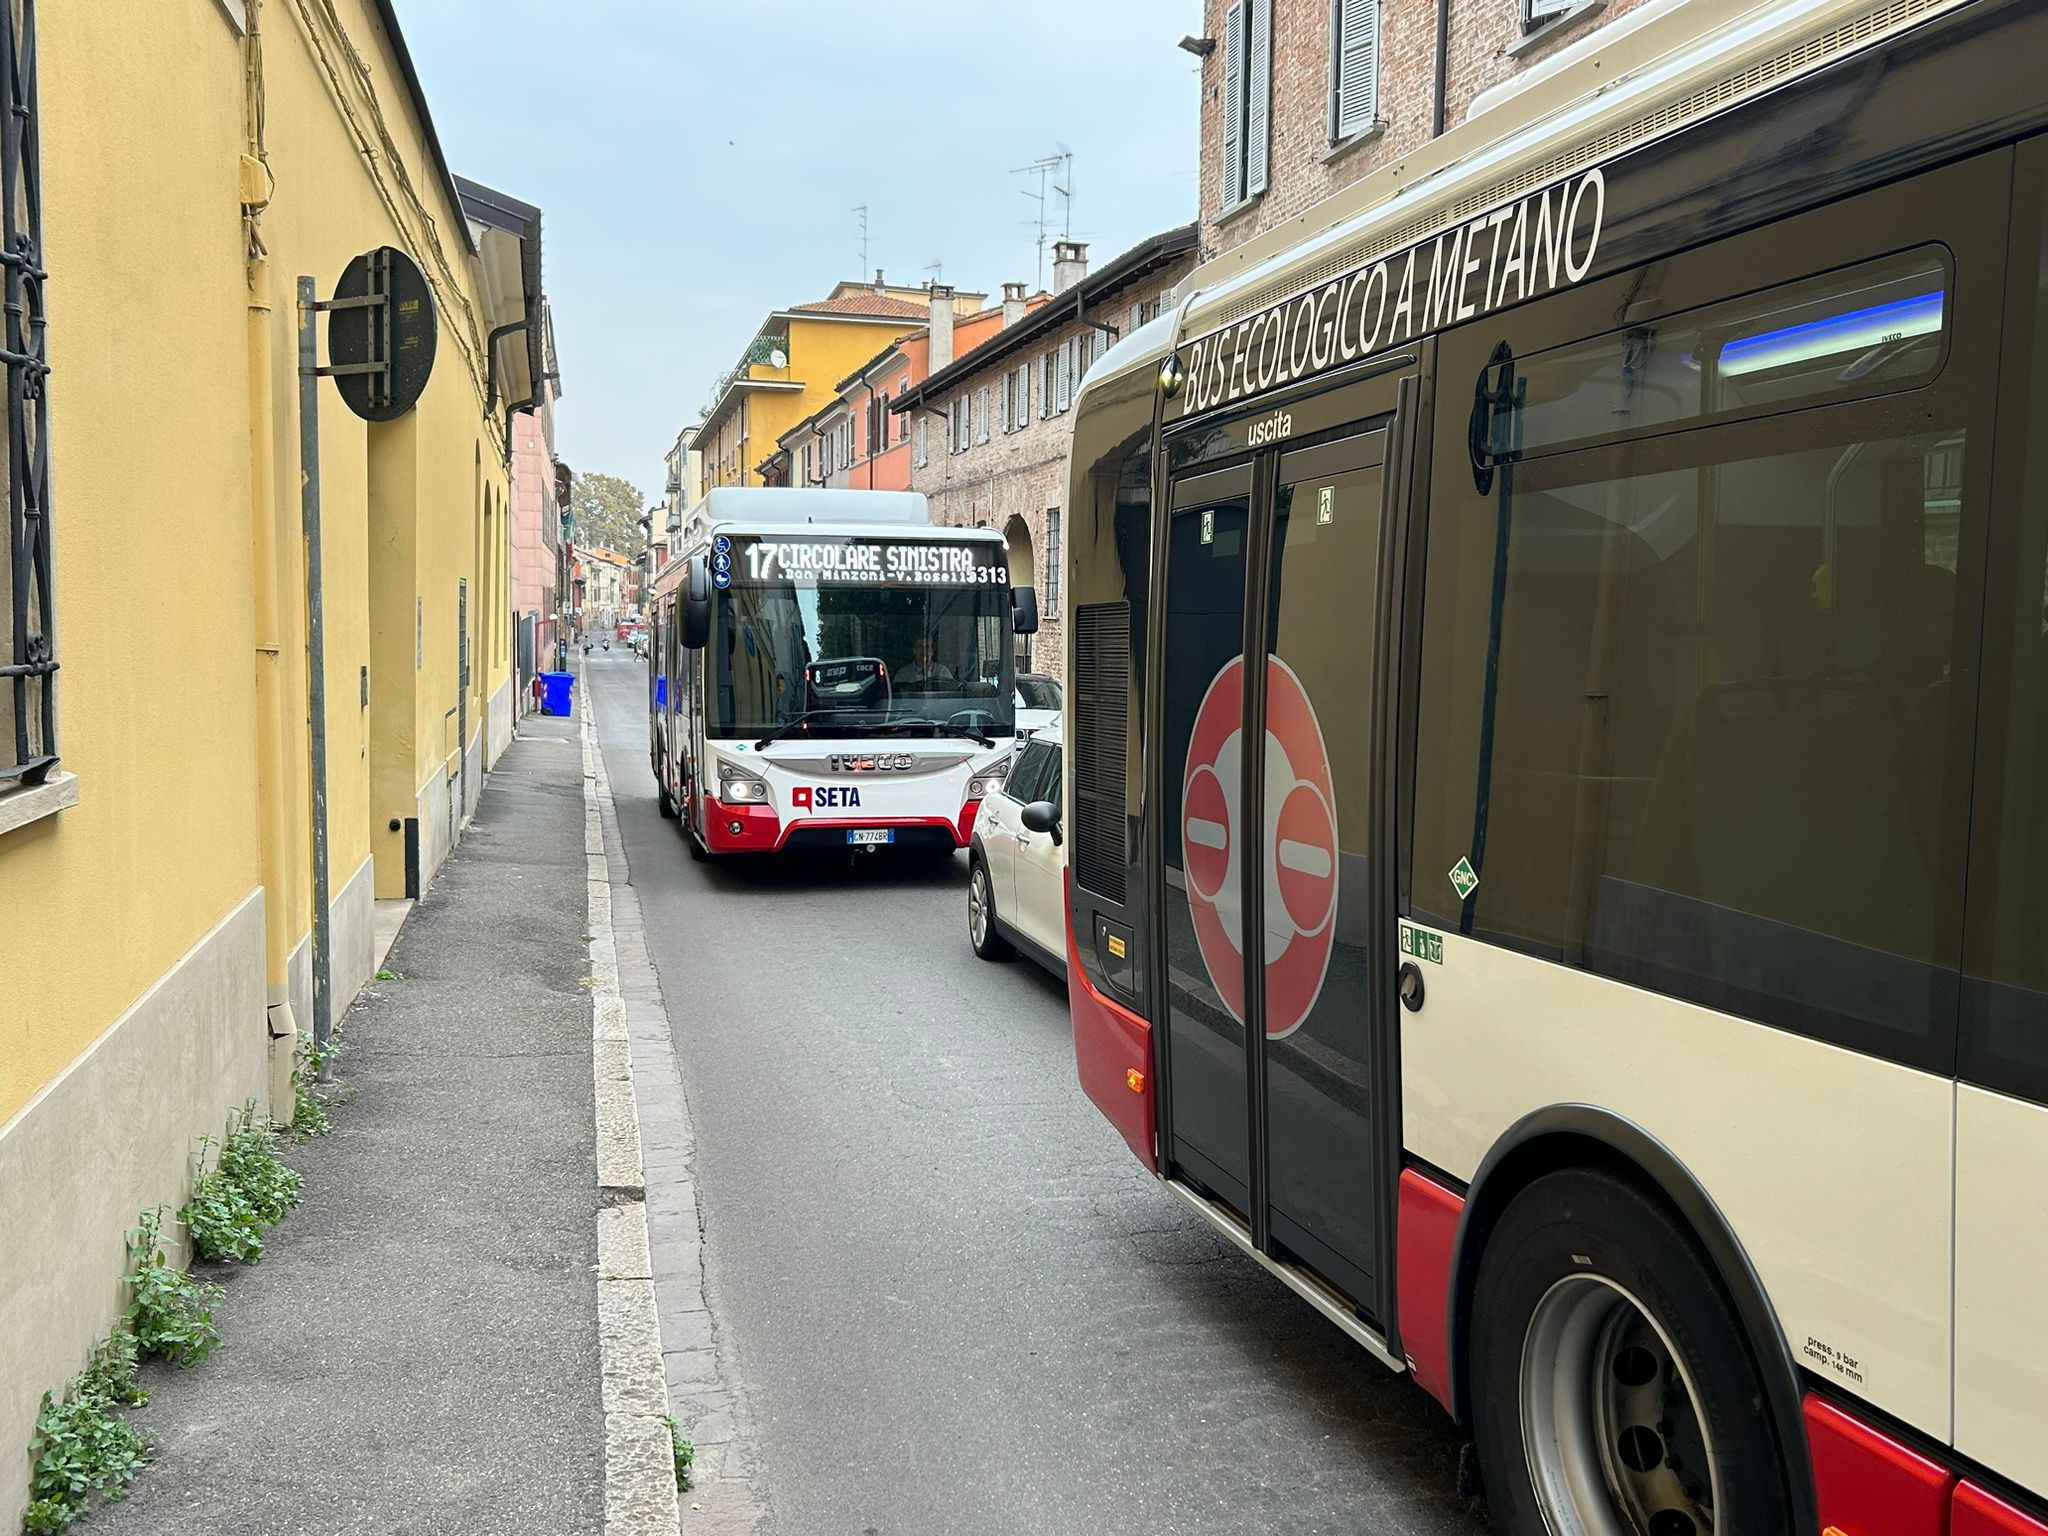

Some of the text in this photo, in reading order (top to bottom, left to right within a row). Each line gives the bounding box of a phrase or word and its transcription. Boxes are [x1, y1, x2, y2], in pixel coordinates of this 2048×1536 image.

[1183, 168, 1606, 416] BUS ECOLOGICO A METANO
[1247, 410, 1292, 448] uscita
[744, 543, 778, 579] 17
[778, 544, 974, 572] CIRCOLARE SINISTRA
[965, 565, 1007, 584] 5313
[830, 753, 914, 772] IVECO
[815, 786, 861, 808] SETA
[1453, 869, 1473, 887] GNC
[1803, 1345, 1830, 1365] camp.
[1845, 1367, 1863, 1383] mm
[1807, 1336, 1858, 1369] press. 9 bar
